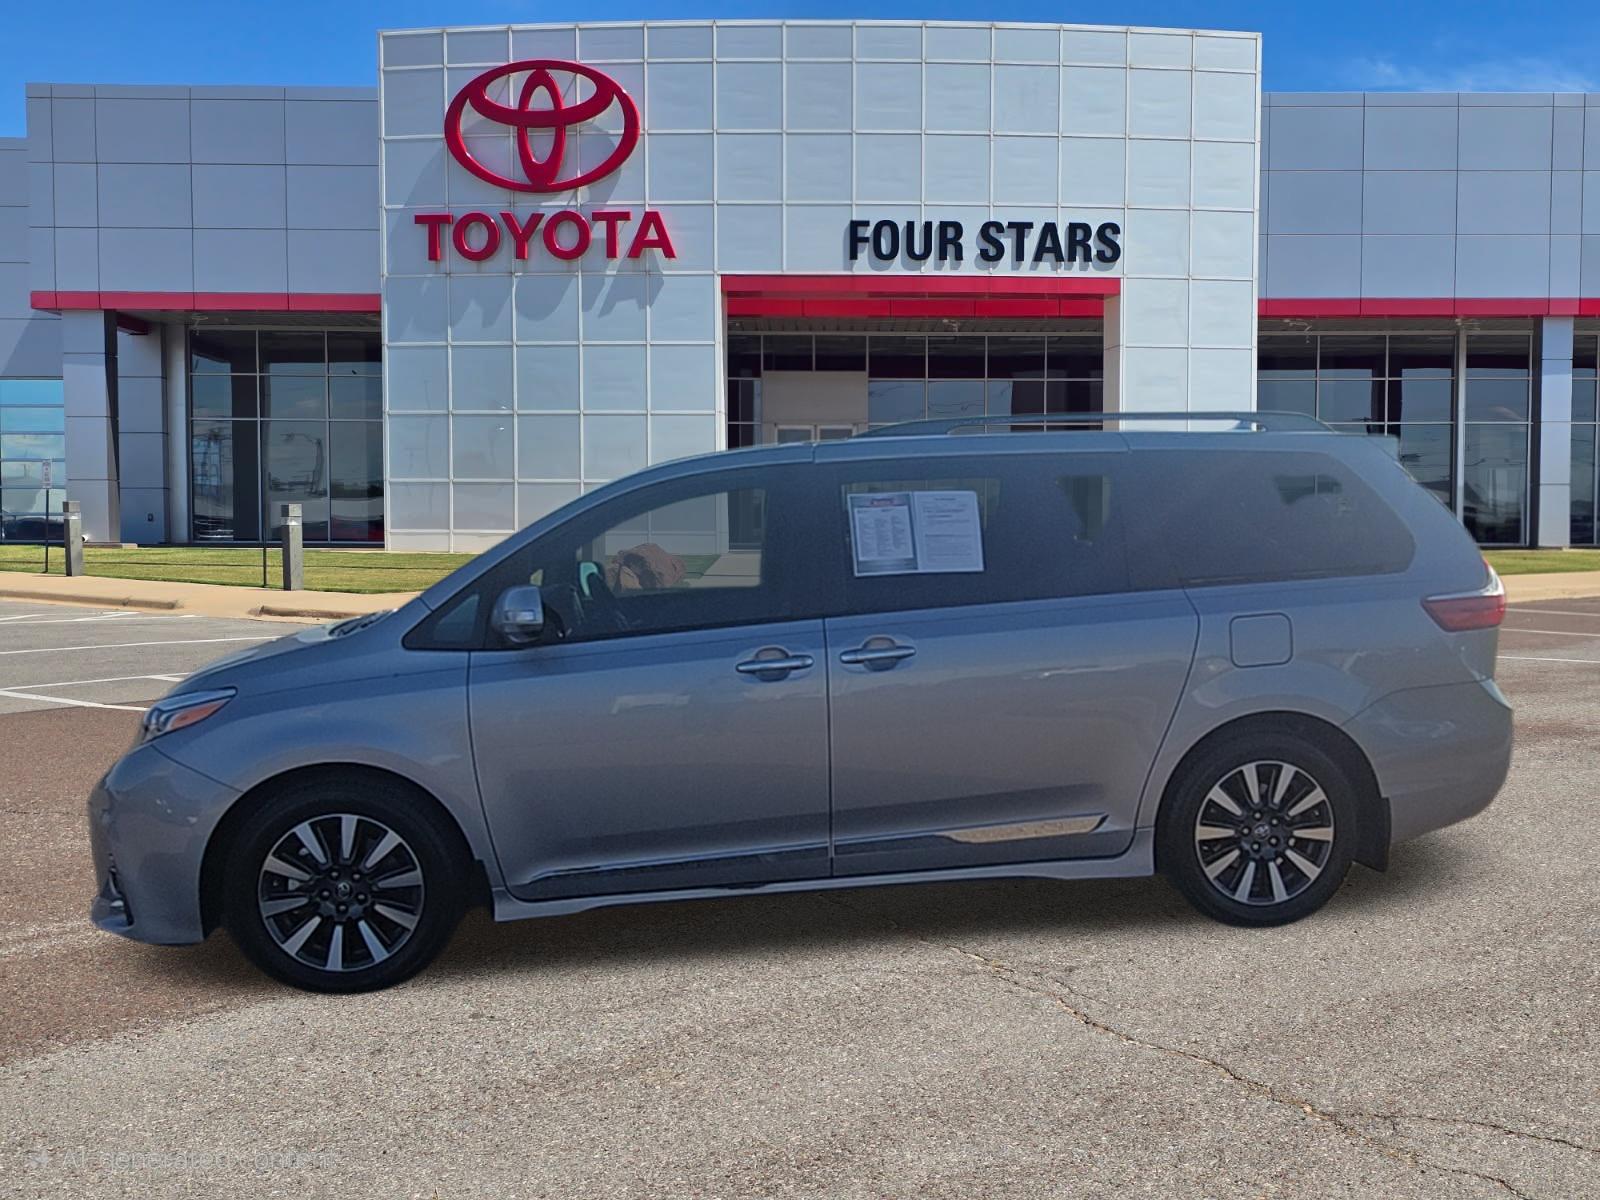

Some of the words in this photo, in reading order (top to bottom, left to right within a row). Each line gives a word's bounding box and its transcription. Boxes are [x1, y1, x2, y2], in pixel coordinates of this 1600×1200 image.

[415, 210, 676, 261] TOYOTA
[849, 219, 964, 262] FOUR
[979, 221, 1121, 264] STARS
